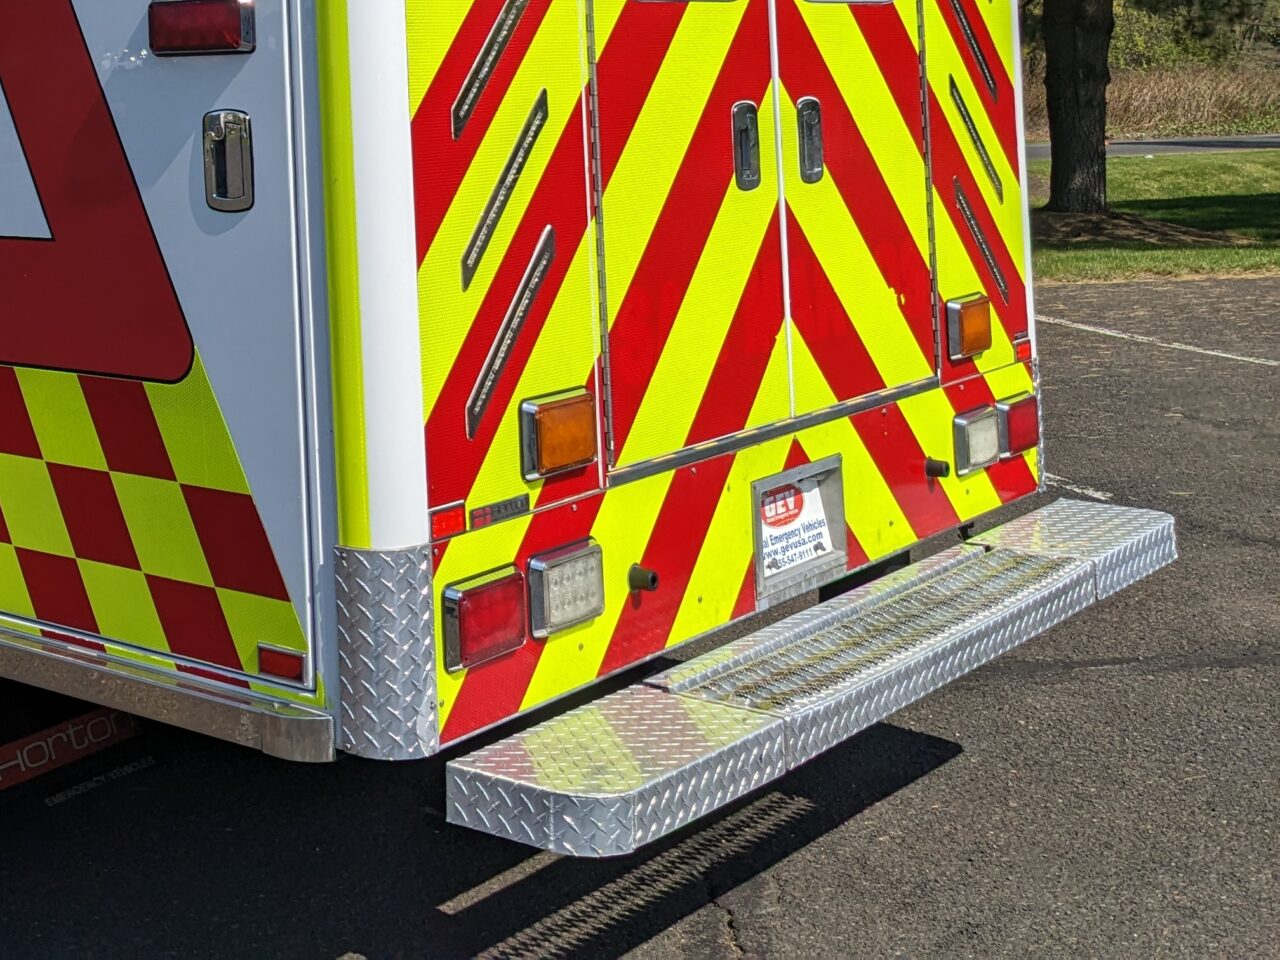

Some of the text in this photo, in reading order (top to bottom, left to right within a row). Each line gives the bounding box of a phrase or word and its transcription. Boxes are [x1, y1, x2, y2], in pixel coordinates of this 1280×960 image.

[764, 489, 795, 518] GEV
[769, 528, 802, 546] Emergency
[801, 518, 826, 534] Vehicles
[777, 547, 813, 568] 55-547-9111
